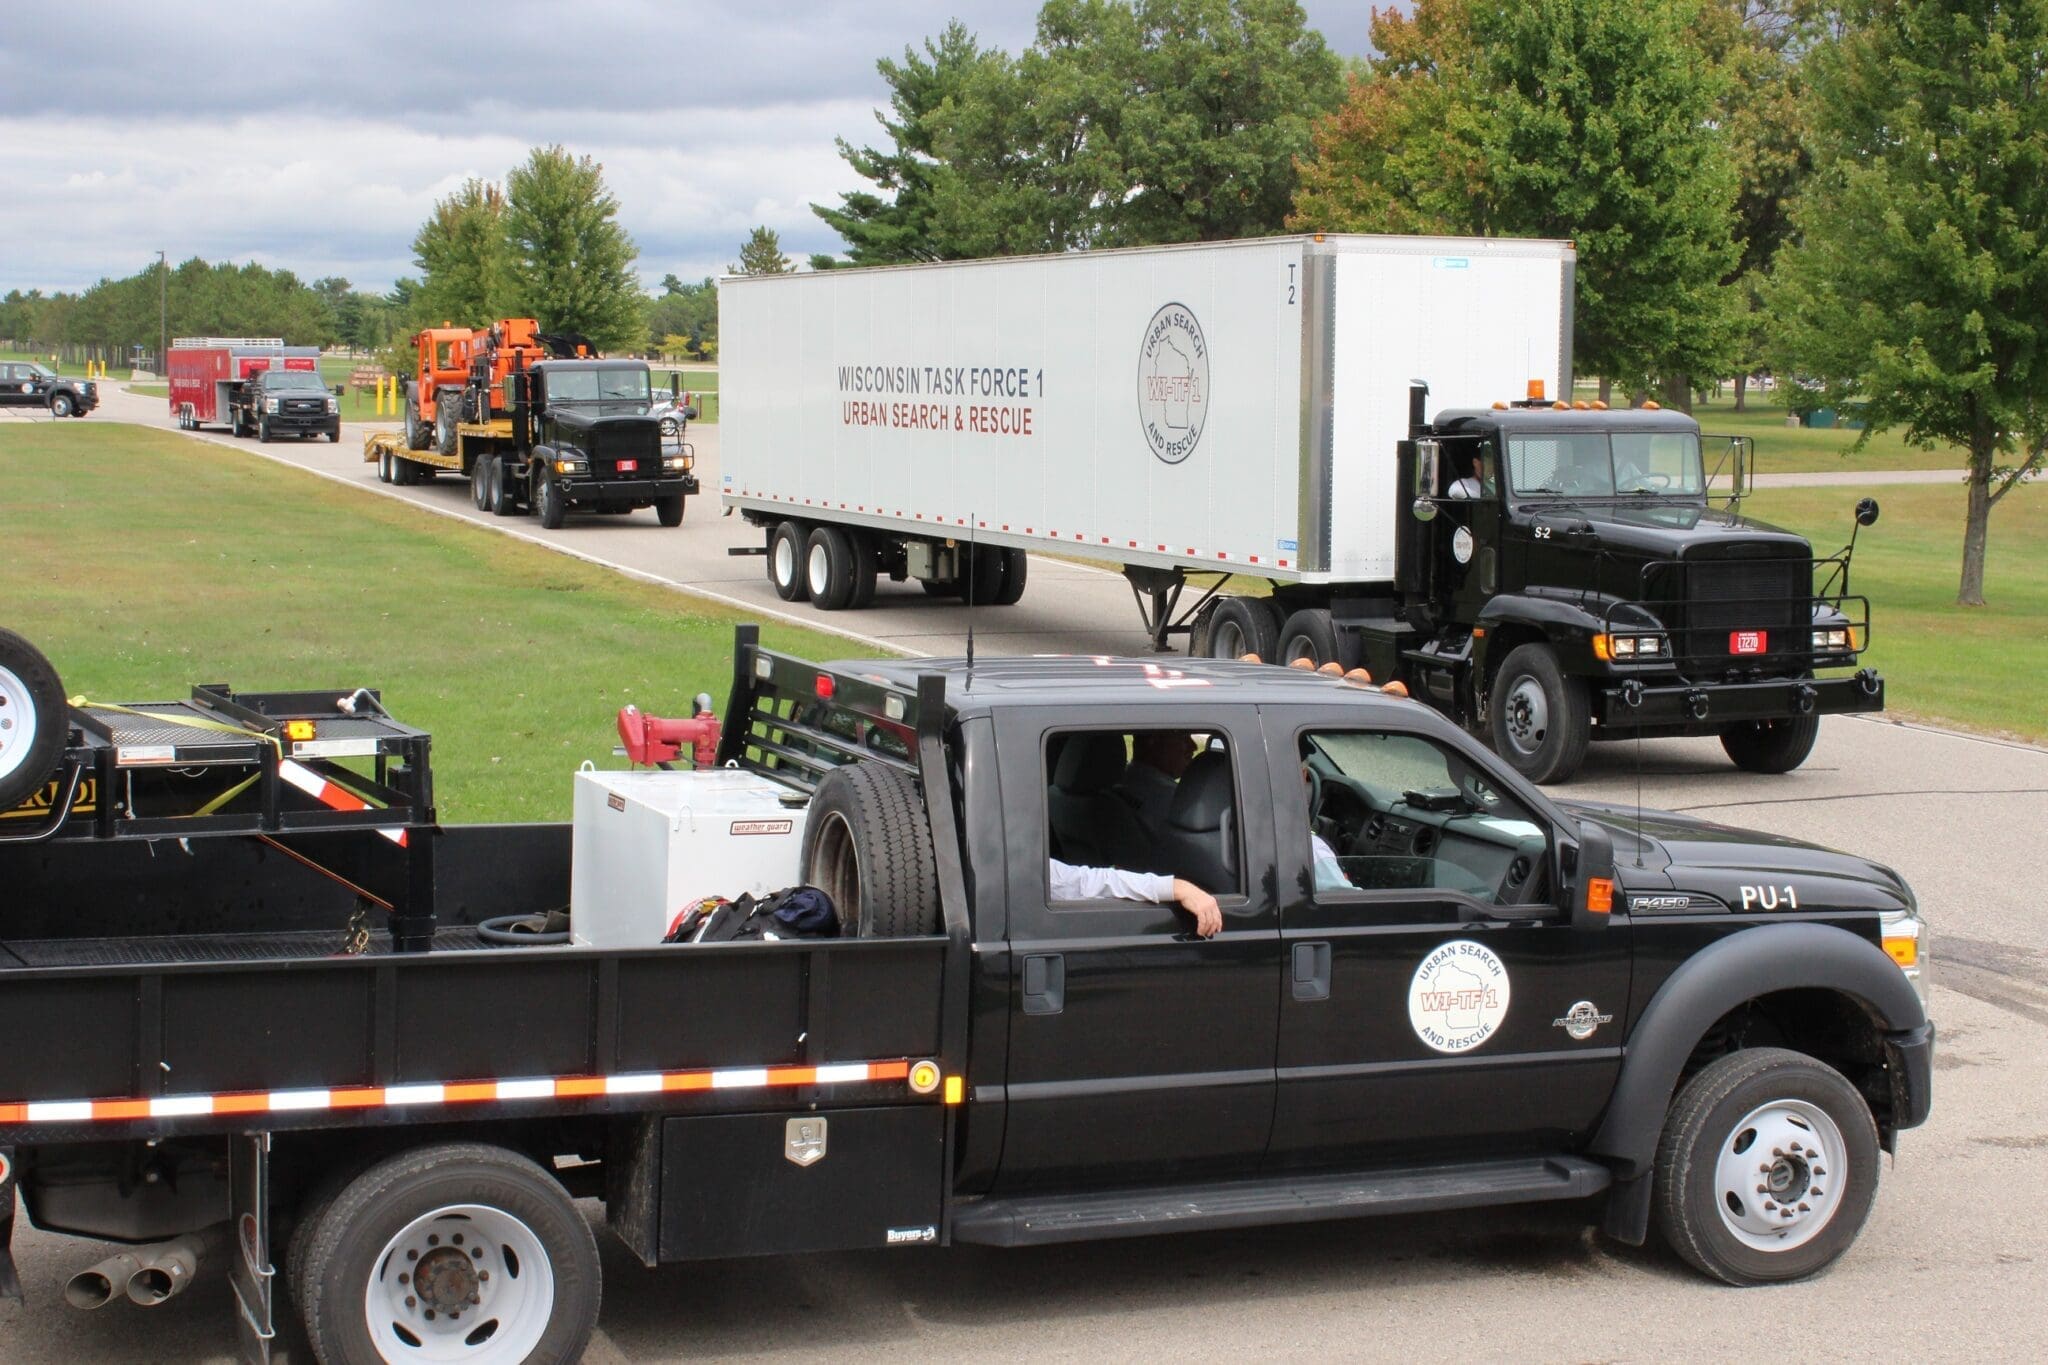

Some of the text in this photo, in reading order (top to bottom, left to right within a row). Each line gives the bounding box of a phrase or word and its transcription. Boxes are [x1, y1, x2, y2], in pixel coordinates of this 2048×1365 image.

[1146, 312, 1204, 359] URBAN SEARCH
[838, 366, 1044, 398] WISCONSIN TASK FORCE 1
[843, 401, 1033, 435] URBAN SEARCH & RESCUE
[1147, 421, 1198, 456] AND RESCUE
[1534, 526, 1551, 539] S-2
[733, 822, 789, 833] weather guard
[1740, 885, 1798, 911] PU-1
[1420, 944, 1502, 981] URBAN SEARCH
[1422, 1022, 1492, 1049] AND RESCUE
[887, 1229, 922, 1242] Buyers
